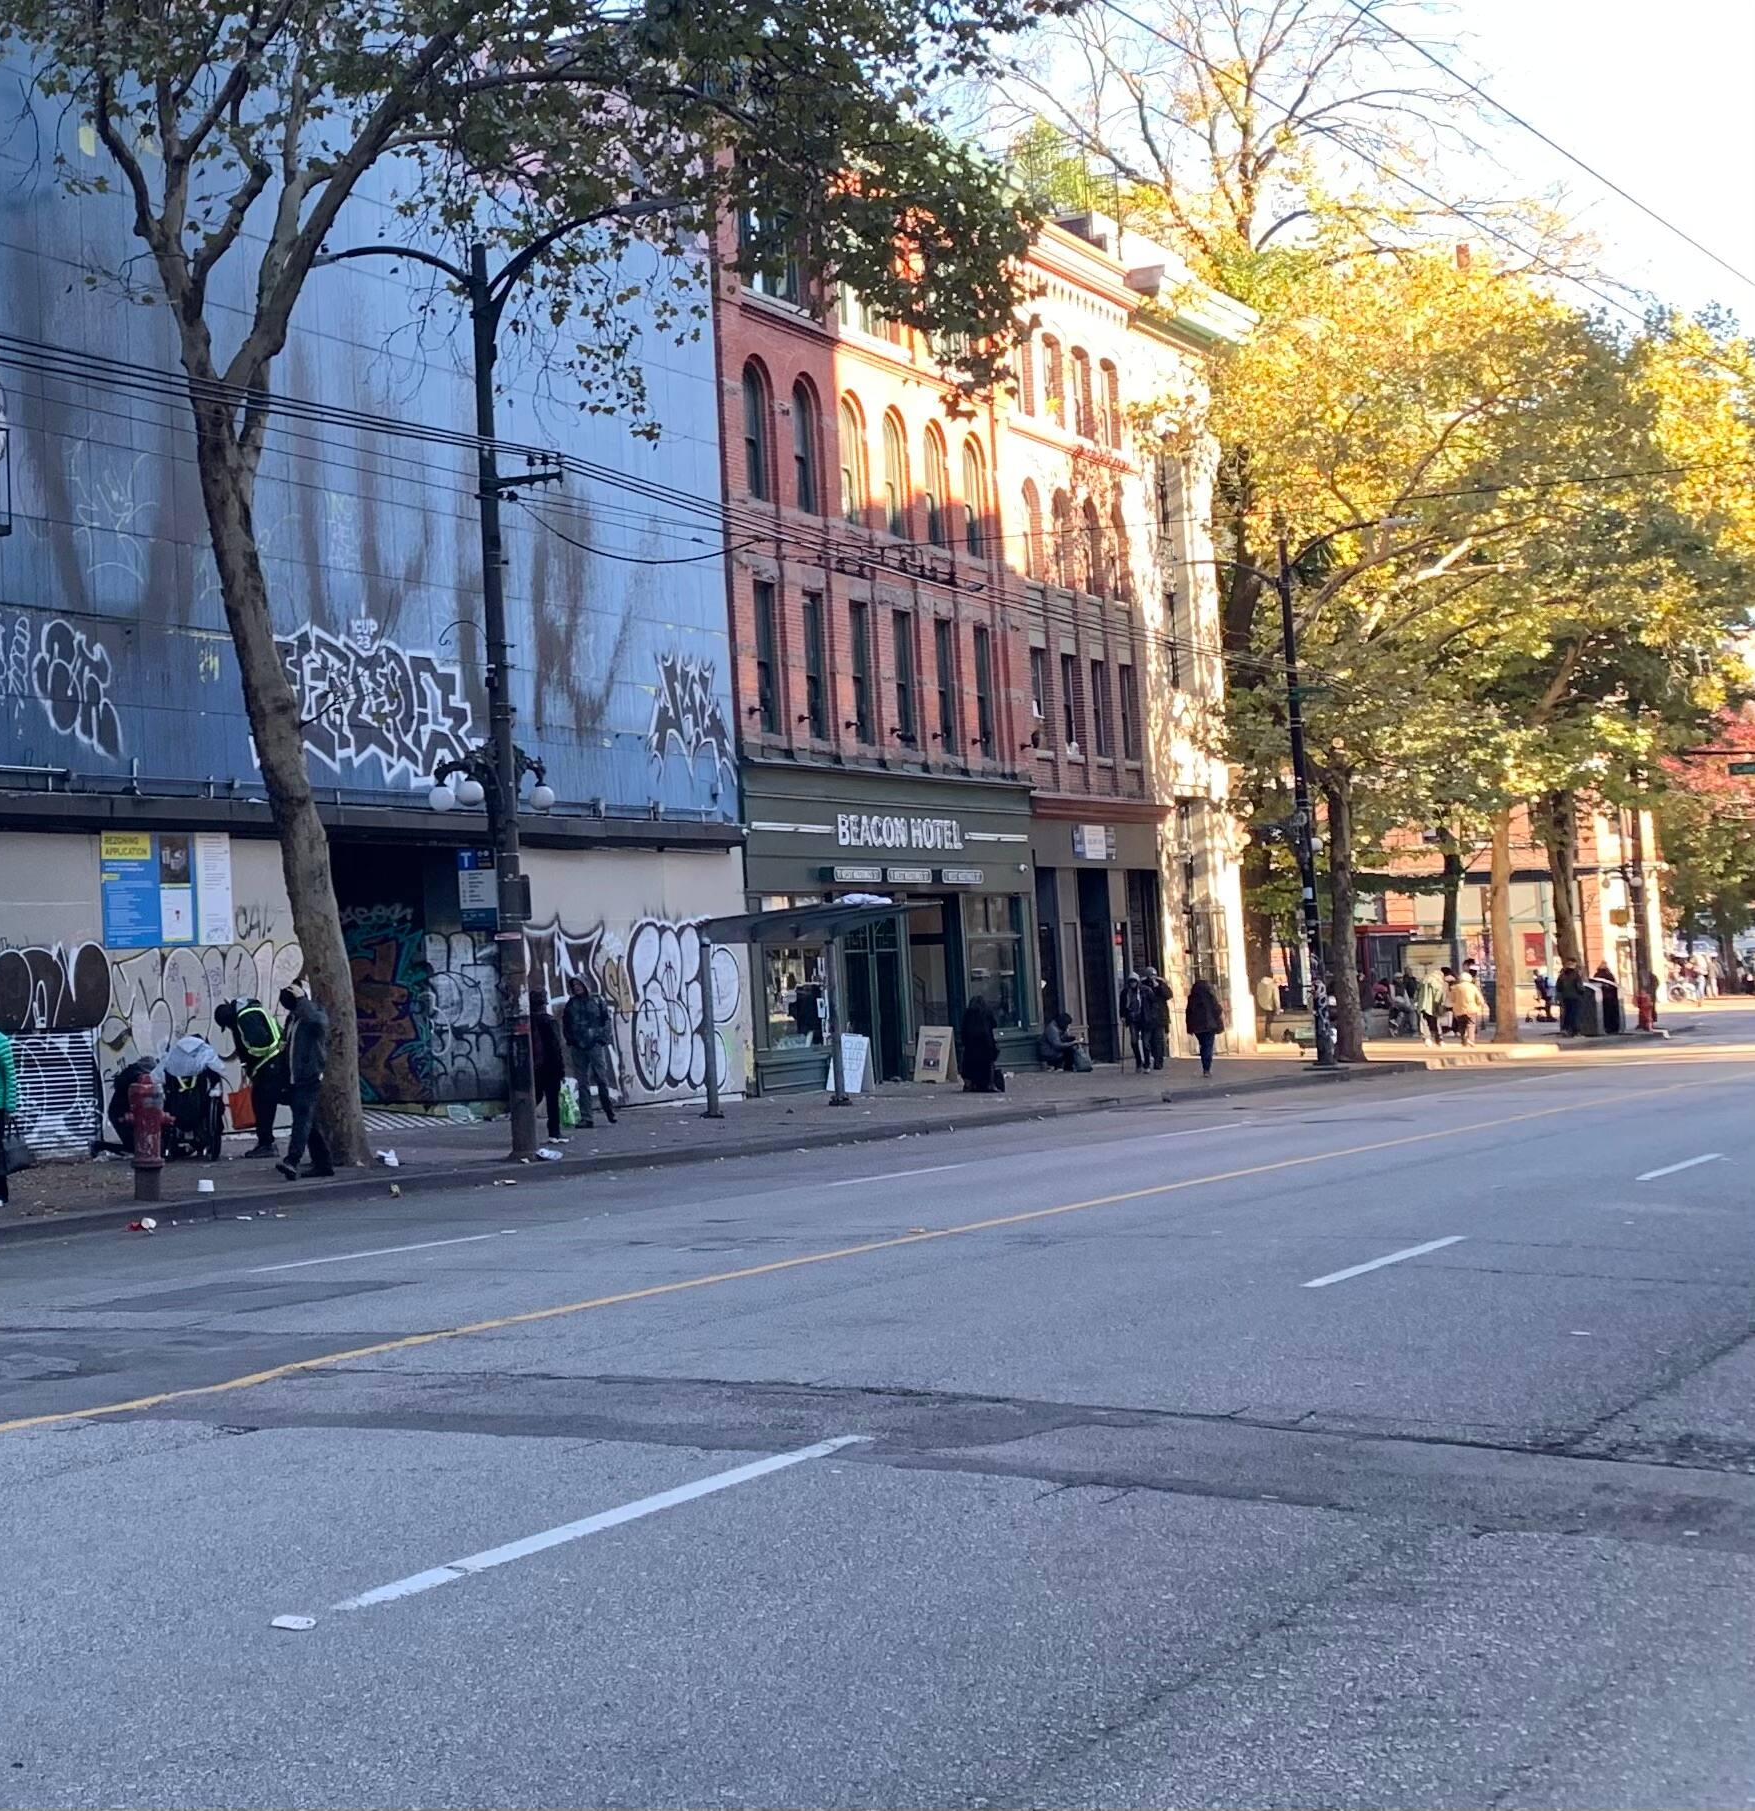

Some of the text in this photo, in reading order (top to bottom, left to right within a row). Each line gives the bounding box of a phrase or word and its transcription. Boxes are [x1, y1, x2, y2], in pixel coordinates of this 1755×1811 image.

[837, 813, 965, 851] BEACON HOTEL
[104, 847, 148, 857] APPLICATION
[460, 852, 472, 868] T
